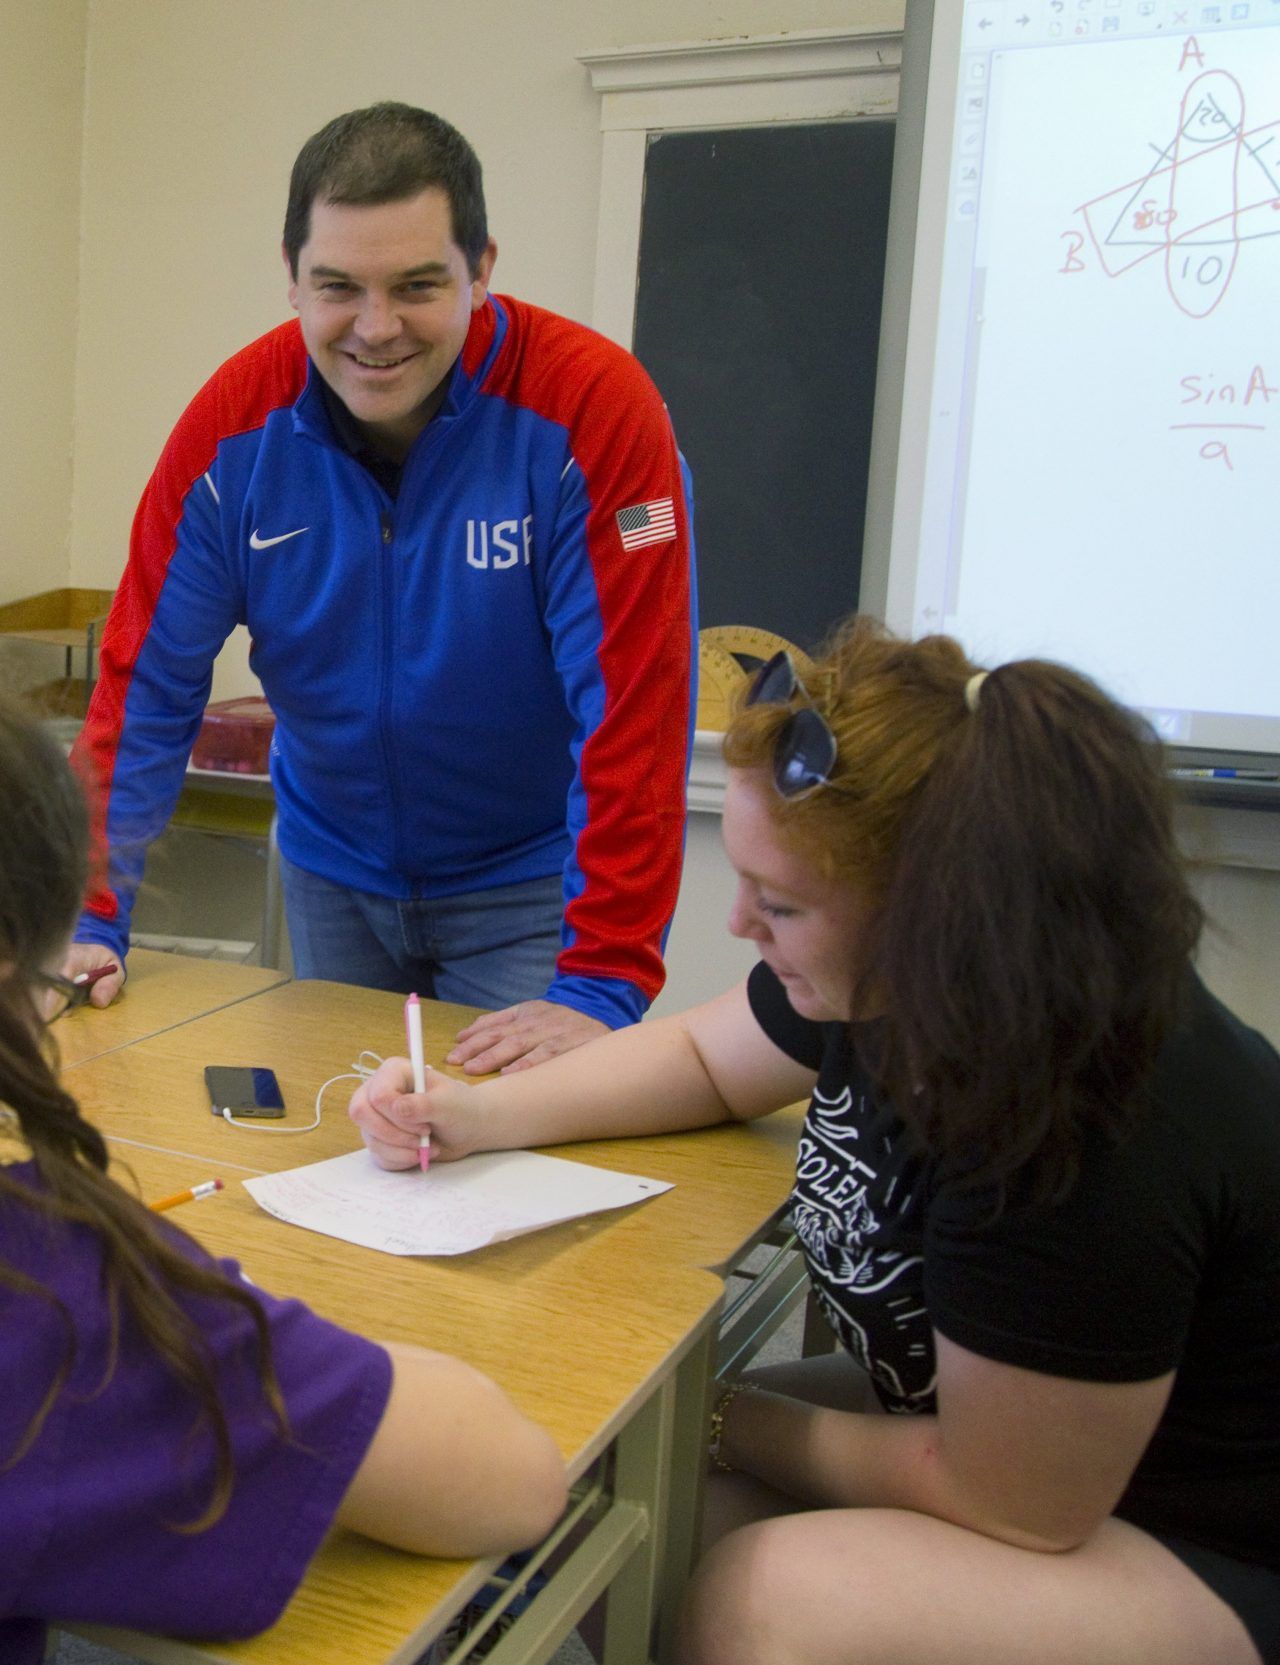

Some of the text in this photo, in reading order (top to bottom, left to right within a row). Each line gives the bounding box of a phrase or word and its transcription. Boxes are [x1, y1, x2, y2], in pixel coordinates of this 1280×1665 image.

[1177, 35, 1205, 71] A
[1058, 231, 1086, 274] B
[1182, 256, 1223, 285] 10
